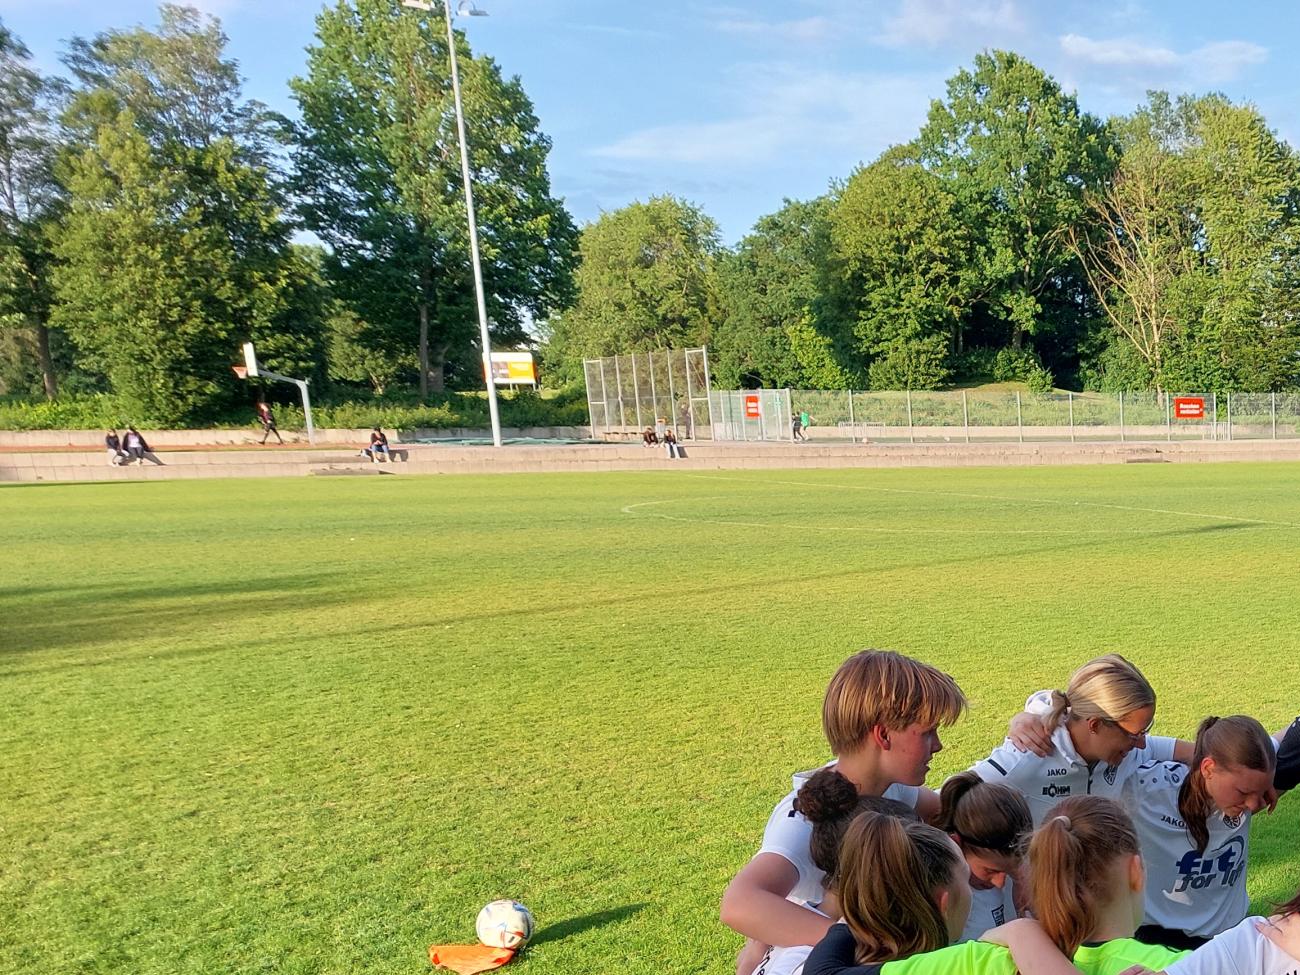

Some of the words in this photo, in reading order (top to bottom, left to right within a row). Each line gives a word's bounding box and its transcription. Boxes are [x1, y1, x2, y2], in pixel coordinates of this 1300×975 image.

[1161, 815, 1185, 828] JAKO
[1176, 846, 1236, 874] fit
[1175, 871, 1217, 892] for
